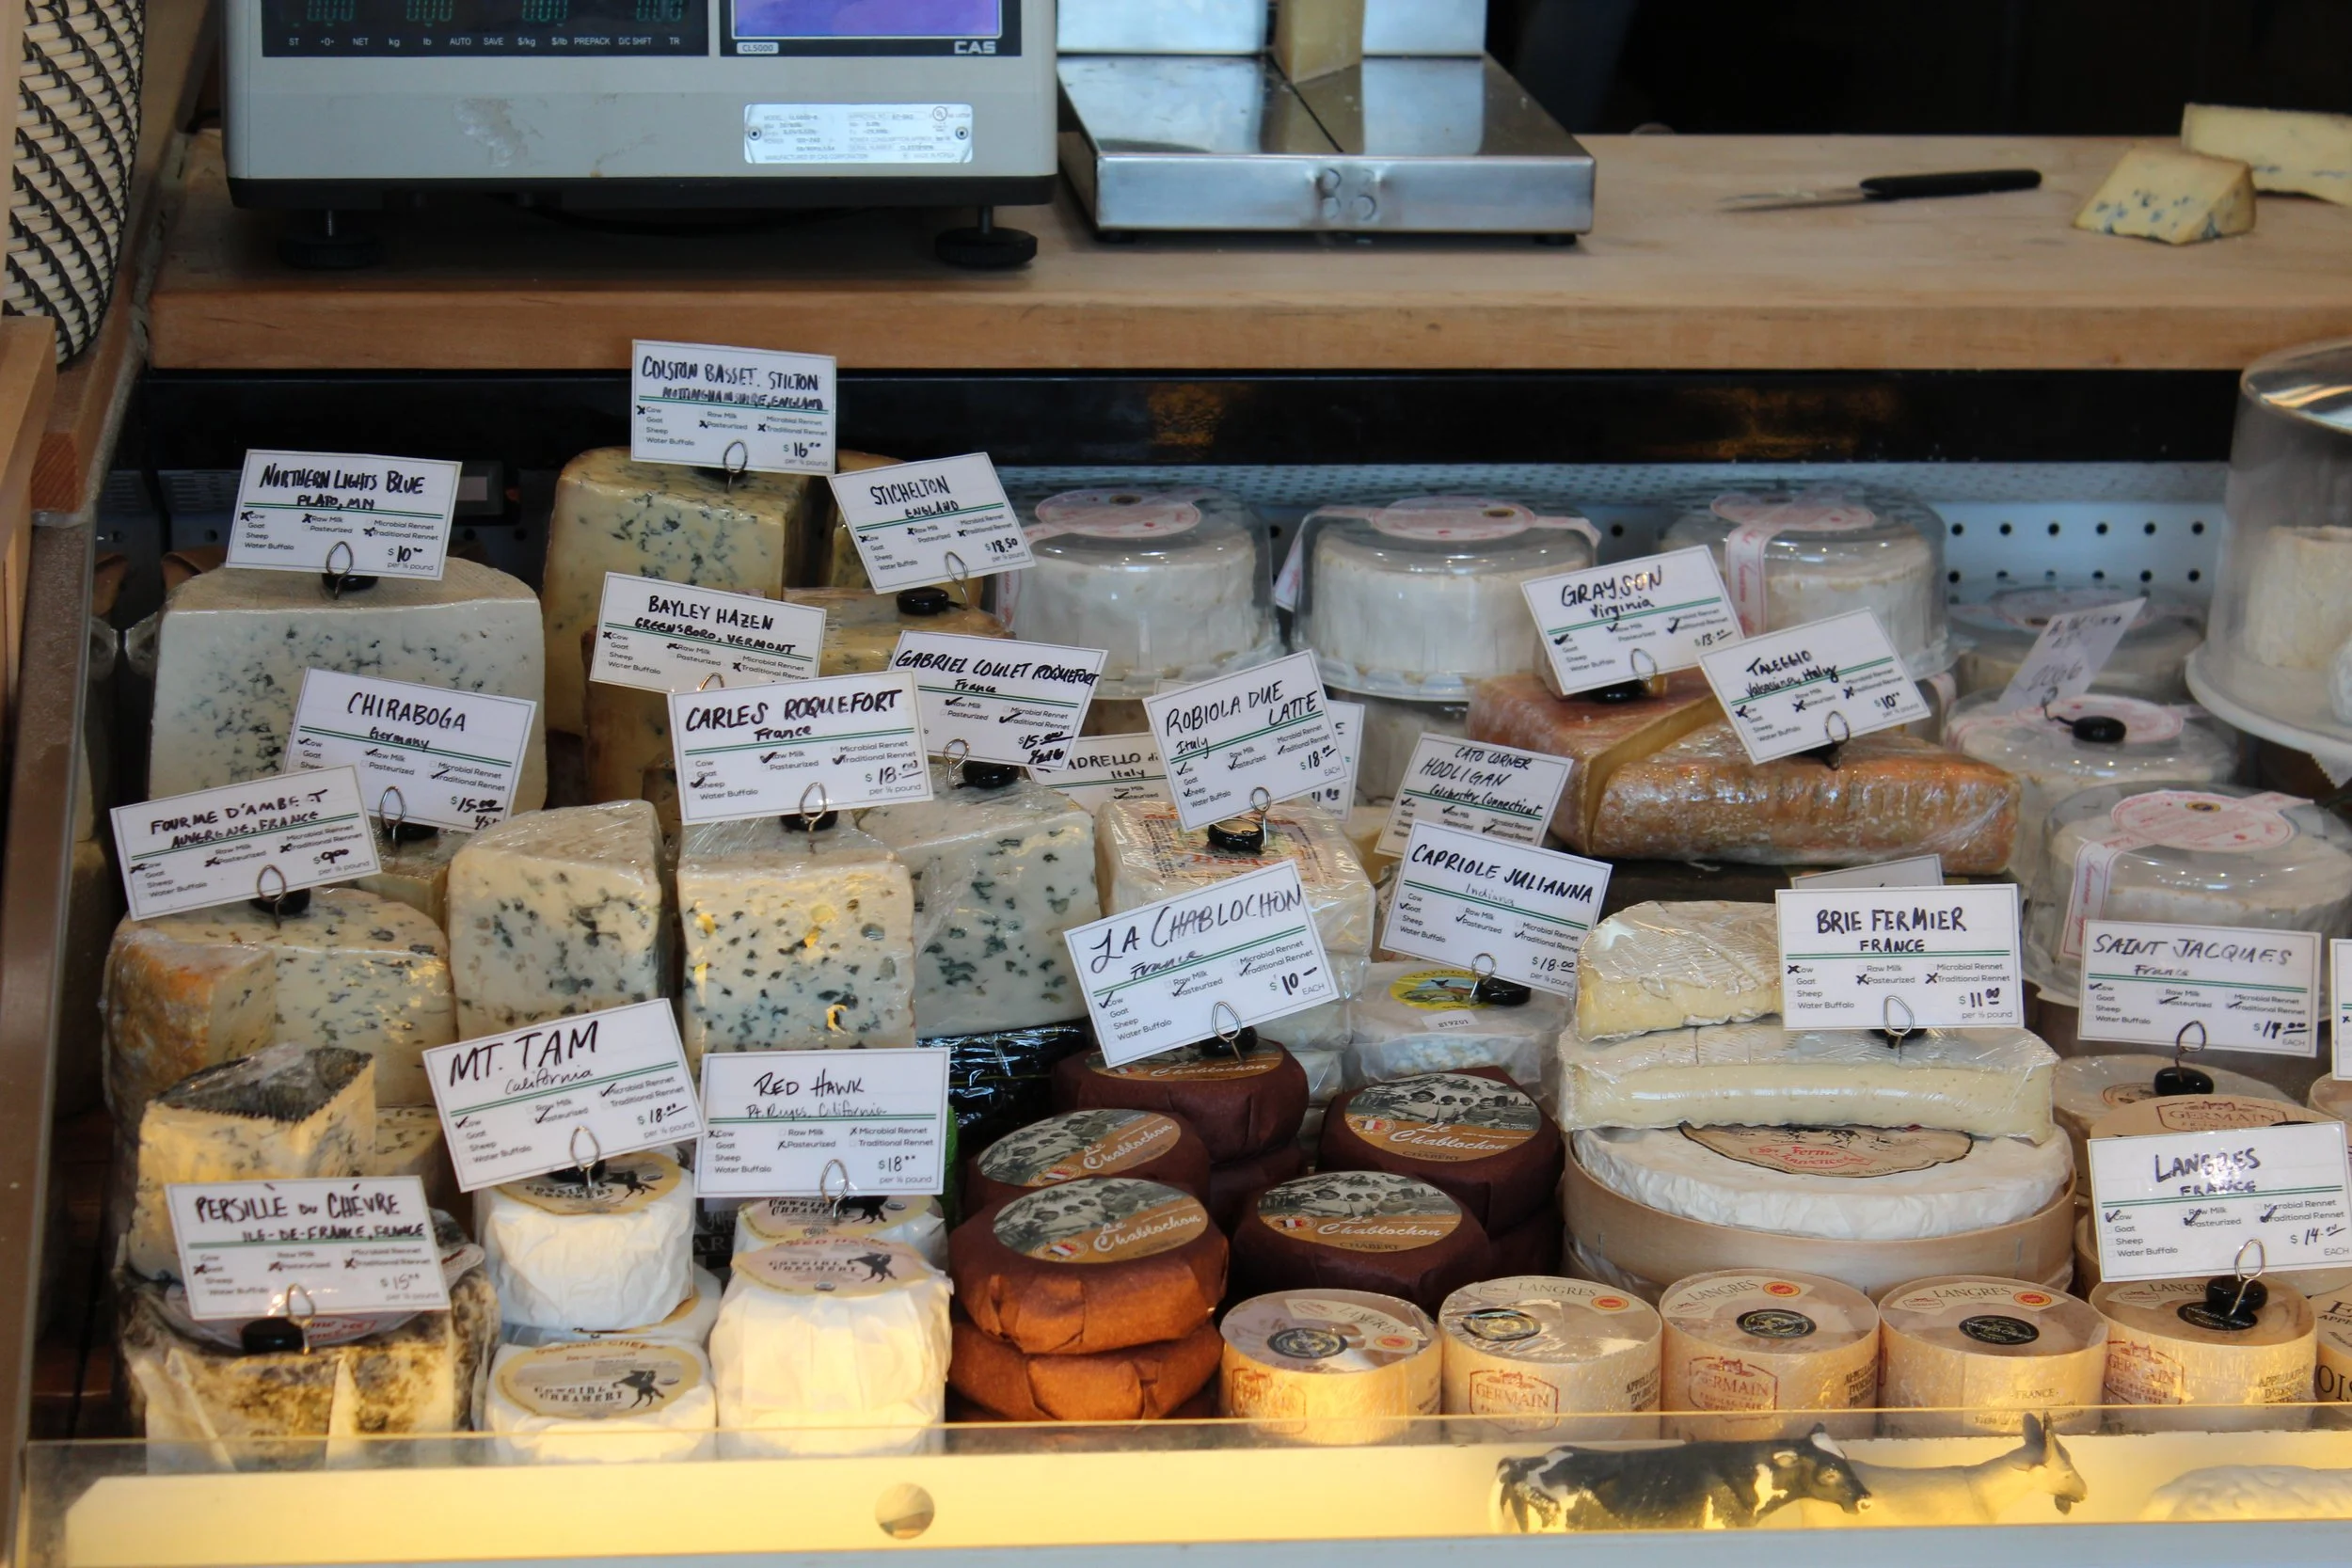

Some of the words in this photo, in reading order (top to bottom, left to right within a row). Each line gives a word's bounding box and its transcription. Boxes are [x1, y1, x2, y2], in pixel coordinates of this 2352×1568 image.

[289, 38, 300, 46] ST
[353, 38, 369, 46] NET
[389, 38, 401, 48] kg
[423, 38, 432, 46] lb
[450, 38, 471, 46] AUTO
[484, 38, 503, 46] SAVE
[574, 38, 611, 46] PREPACK
[670, 38, 680, 46] TR
[953, 41, 996, 55] CAS
[642, 356, 698, 381] COLSTON
[769, 372, 819, 391] STILTON
[259, 463, 331, 489] NORTHERN
[333, 469, 377, 491] LIGHTS
[386, 470, 425, 495] BLUE
[869, 475, 951, 506] STICHELTON
[347, 497, 375, 511] MN
[904, 499, 961, 518] ENGLAND
[1561, 564, 1662, 607] GRAYSON
[647, 594, 711, 621] BAYLEY
[716, 608, 774, 631] HAZEN
[1590, 596, 1655, 621] Virginia
[726, 634, 797, 655] VERMONT
[895, 650, 968, 674] GABRIEL
[973, 659, 1032, 679] COULET
[1804, 665, 1839, 684] Italy
[954, 679, 997, 693] France
[346, 691, 468, 732] CHIRABOGA
[686, 702, 770, 732] CARLES
[784, 689, 903, 721] ROQUEFORT
[947, 709, 989, 721] Pasteurized
[1167, 697, 1242, 737] ROBIOLA
[1248, 680, 1285, 708] DUE
[1268, 690, 1318, 726] LATTE
[370, 726, 430, 752] Germany
[754, 724, 813, 741] France
[840, 743, 878, 753] Microbial
[879, 739, 909, 749] Rennet
[1176, 736, 1210, 760] Italy
[770, 759, 819, 771] Pasteurized
[1068, 752, 1141, 769] ADRELLO
[1454, 747, 1485, 762] CATO
[1487, 752, 1533, 770] CORNER
[1110, 769, 1146, 779] Italy
[1419, 757, 1512, 787] HOOLIGAN
[726, 787, 759, 799] Buffalo
[151, 811, 219, 835] FOURME
[225, 789, 328, 819] D'AMBET
[1482, 791, 1543, 816] Connecticut
[258, 811, 319, 832] FRANCE
[1411, 844, 1502, 879] CAPRIOLE
[1503, 868, 1594, 904] JULIANNA
[1090, 925, 1140, 974] LA
[1151, 883, 1301, 947] CHABLOCHON
[1462, 920, 1502, 935] Pasteurized
[1816, 909, 1863, 934] BRIE
[1871, 907, 1967, 932] FERMIER
[1239, 948, 1275, 965] Microbial
[1275, 940, 1304, 956] Rennet
[1860, 938, 1925, 953] FRANCE
[2093, 934, 2168, 958] SAINT
[2172, 938, 2292, 965] JACQUES
[1130, 950, 1204, 980] France
[1797, 990, 1822, 999] Sheep
[1113, 1017, 1139, 1029] Sheep
[1143, 1020, 1172, 1035] Buffalo
[450, 1042, 504, 1086] MT.
[515, 1020, 599, 1070] TAM
[505, 1065, 594, 1095] California
[754, 1071, 800, 1097] RED
[810, 1068, 865, 1098] HAWK
[2169, 1110, 2277, 1123] GERMAIN
[1423, 1122, 1451, 1133] Le
[1083, 1123, 1173, 1169] Chablochon
[1389, 1131, 1507, 1151] Chablochon
[741, 1164, 771, 1173] Buffalo
[2180, 1180, 2257, 1196] FRANCE
[771, 1206, 851, 1215] CREAMEY
[2307, 1199, 2337, 1208] Rennet
[2313, 1211, 2345, 1220] Rennet
[1093, 1213, 1201, 1251] Chablochon
[1100, 1221, 1126, 1234] Le
[1317, 1223, 1442, 1237] Chablochon
[2114, 1225, 2136, 1234] Goat
[2116, 1237, 2144, 1246] Sheep
[2117, 1248, 2145, 1258] Water
[2146, 1246, 2179, 1256] Buffalo
[2324, 1246, 2349, 1256] EACH
[1518, 1280, 1597, 1298] LANGRES
[1689, 1278, 1757, 1303] LANGRES
[1933, 1284, 2010, 1299] LANGRES
[2149, 1283, 2205, 1294] LANGR
[1475, 1384, 1549, 1408] GERMAIN
